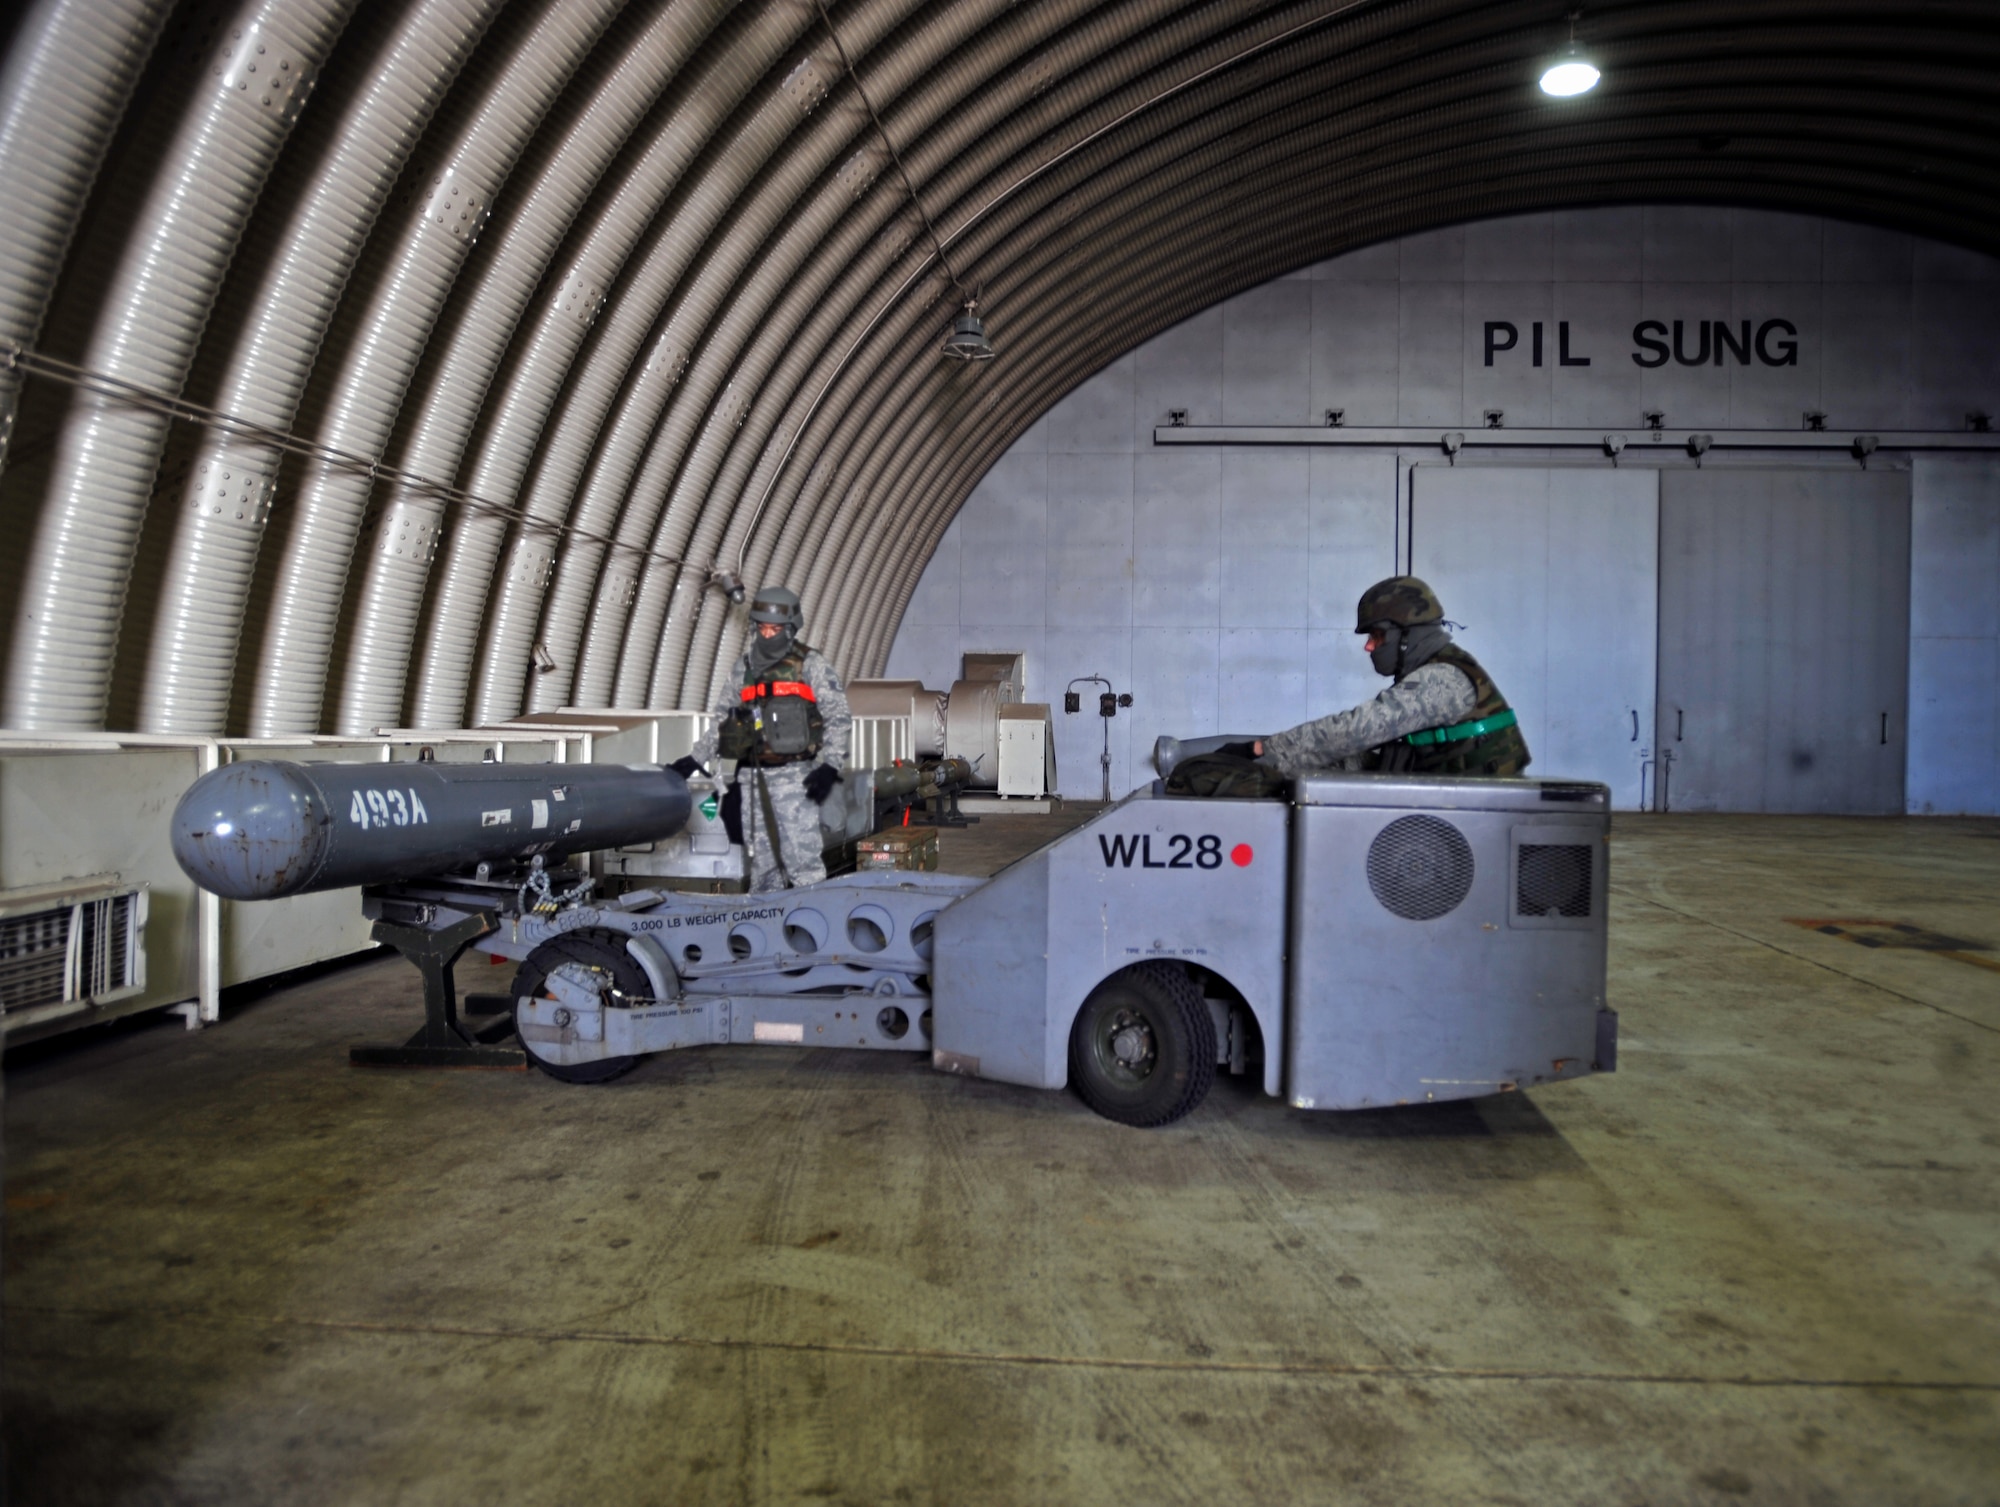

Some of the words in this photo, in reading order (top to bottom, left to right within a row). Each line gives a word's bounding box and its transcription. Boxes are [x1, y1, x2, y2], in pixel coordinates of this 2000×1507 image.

[1484, 321, 1591, 367] PIL
[1631, 318, 1798, 368] SUNG
[350, 788, 428, 830] 493A
[1098, 834, 1223, 869] WL28
[631, 919, 663, 932] 3,000
[667, 918, 681, 929] LB
[685, 913, 728, 926] WEIGHT
[732, 907, 785, 922] CAPACITY
[645, 1010, 678, 1019] PRESSURE
